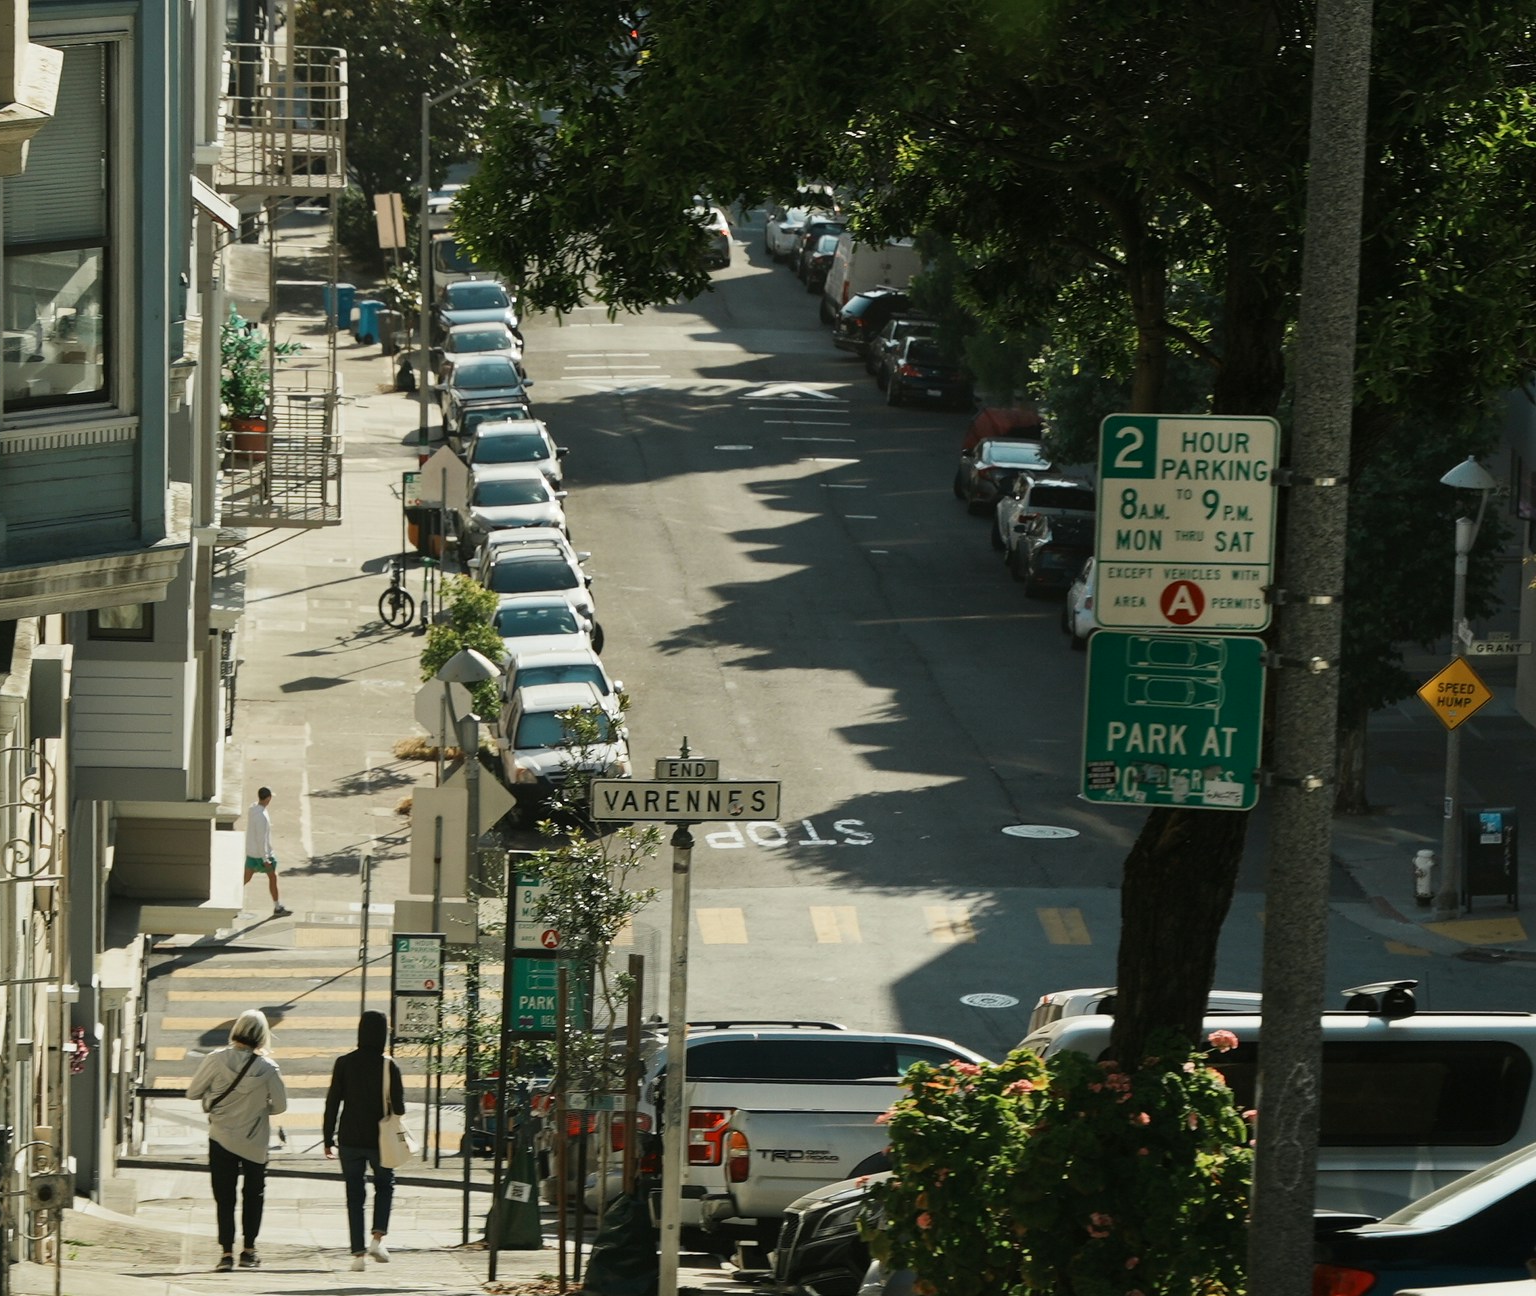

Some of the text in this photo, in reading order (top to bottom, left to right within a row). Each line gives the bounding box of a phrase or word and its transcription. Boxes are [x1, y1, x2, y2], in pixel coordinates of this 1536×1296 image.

[1115, 426, 1249, 468] 2 HOUR
[1161, 459, 1268, 482] PARKING
[1176, 489, 1193, 500] TO
[1116, 529, 1255, 552] MON THRU SAT
[1108, 567, 1261, 581] EXCEPT VEHICLES WITH
[1114, 585, 1261, 616] AREA A PERMITS
[1476, 644, 1524, 653] GRANT
[1437, 682, 1475, 694] SPEED
[1437, 696, 1472, 708] HUMP
[1107, 721, 1238, 757] PARK AT
[669, 762, 706, 777] END
[705, 818, 874, 849] STOP
[399, 940, 408, 951] 2
[519, 995, 555, 1010] PARK
[756, 1149, 804, 1162] TRD
